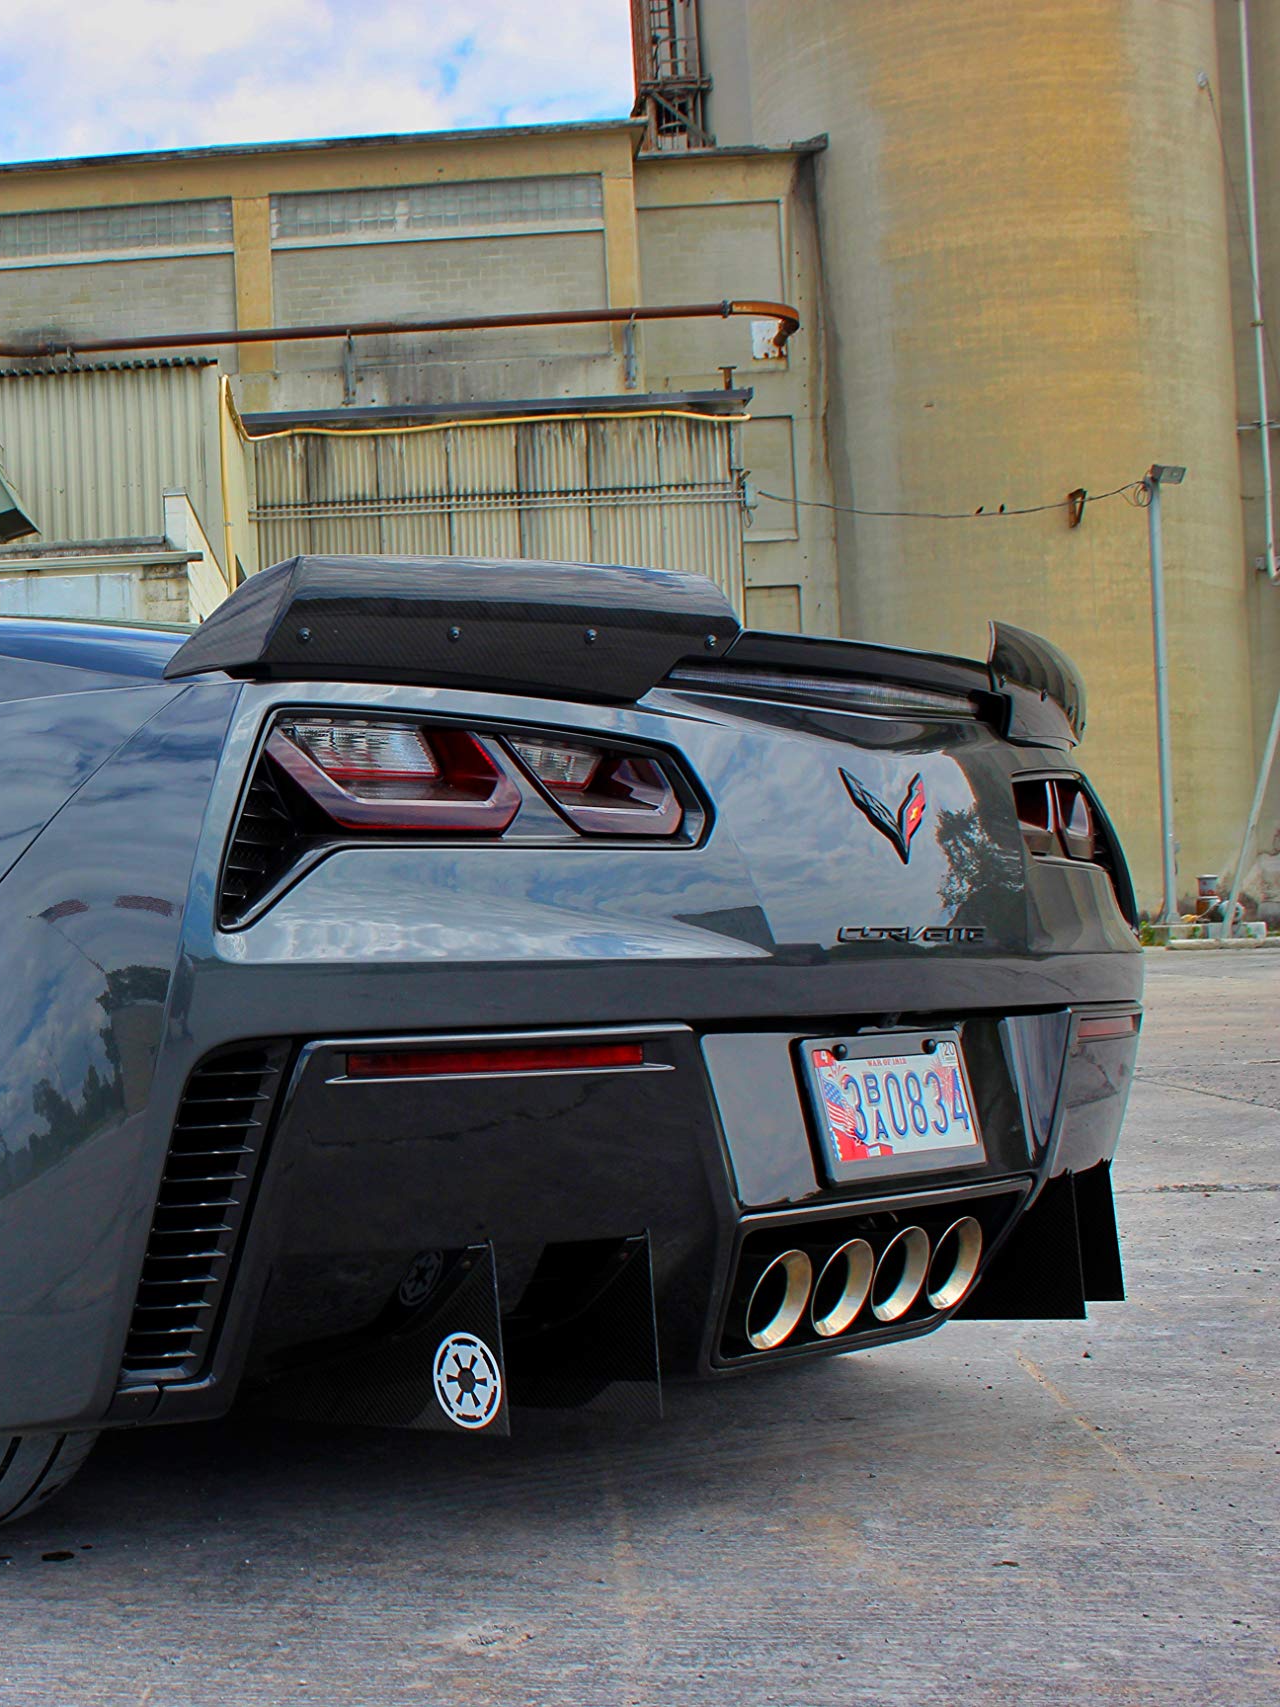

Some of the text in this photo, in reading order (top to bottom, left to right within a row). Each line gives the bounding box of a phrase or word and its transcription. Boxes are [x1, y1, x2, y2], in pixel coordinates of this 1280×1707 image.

[837, 926, 986, 943] CORVETTE
[819, 1050, 829, 1064] 4
[866, 1059, 882, 1067] WAR
